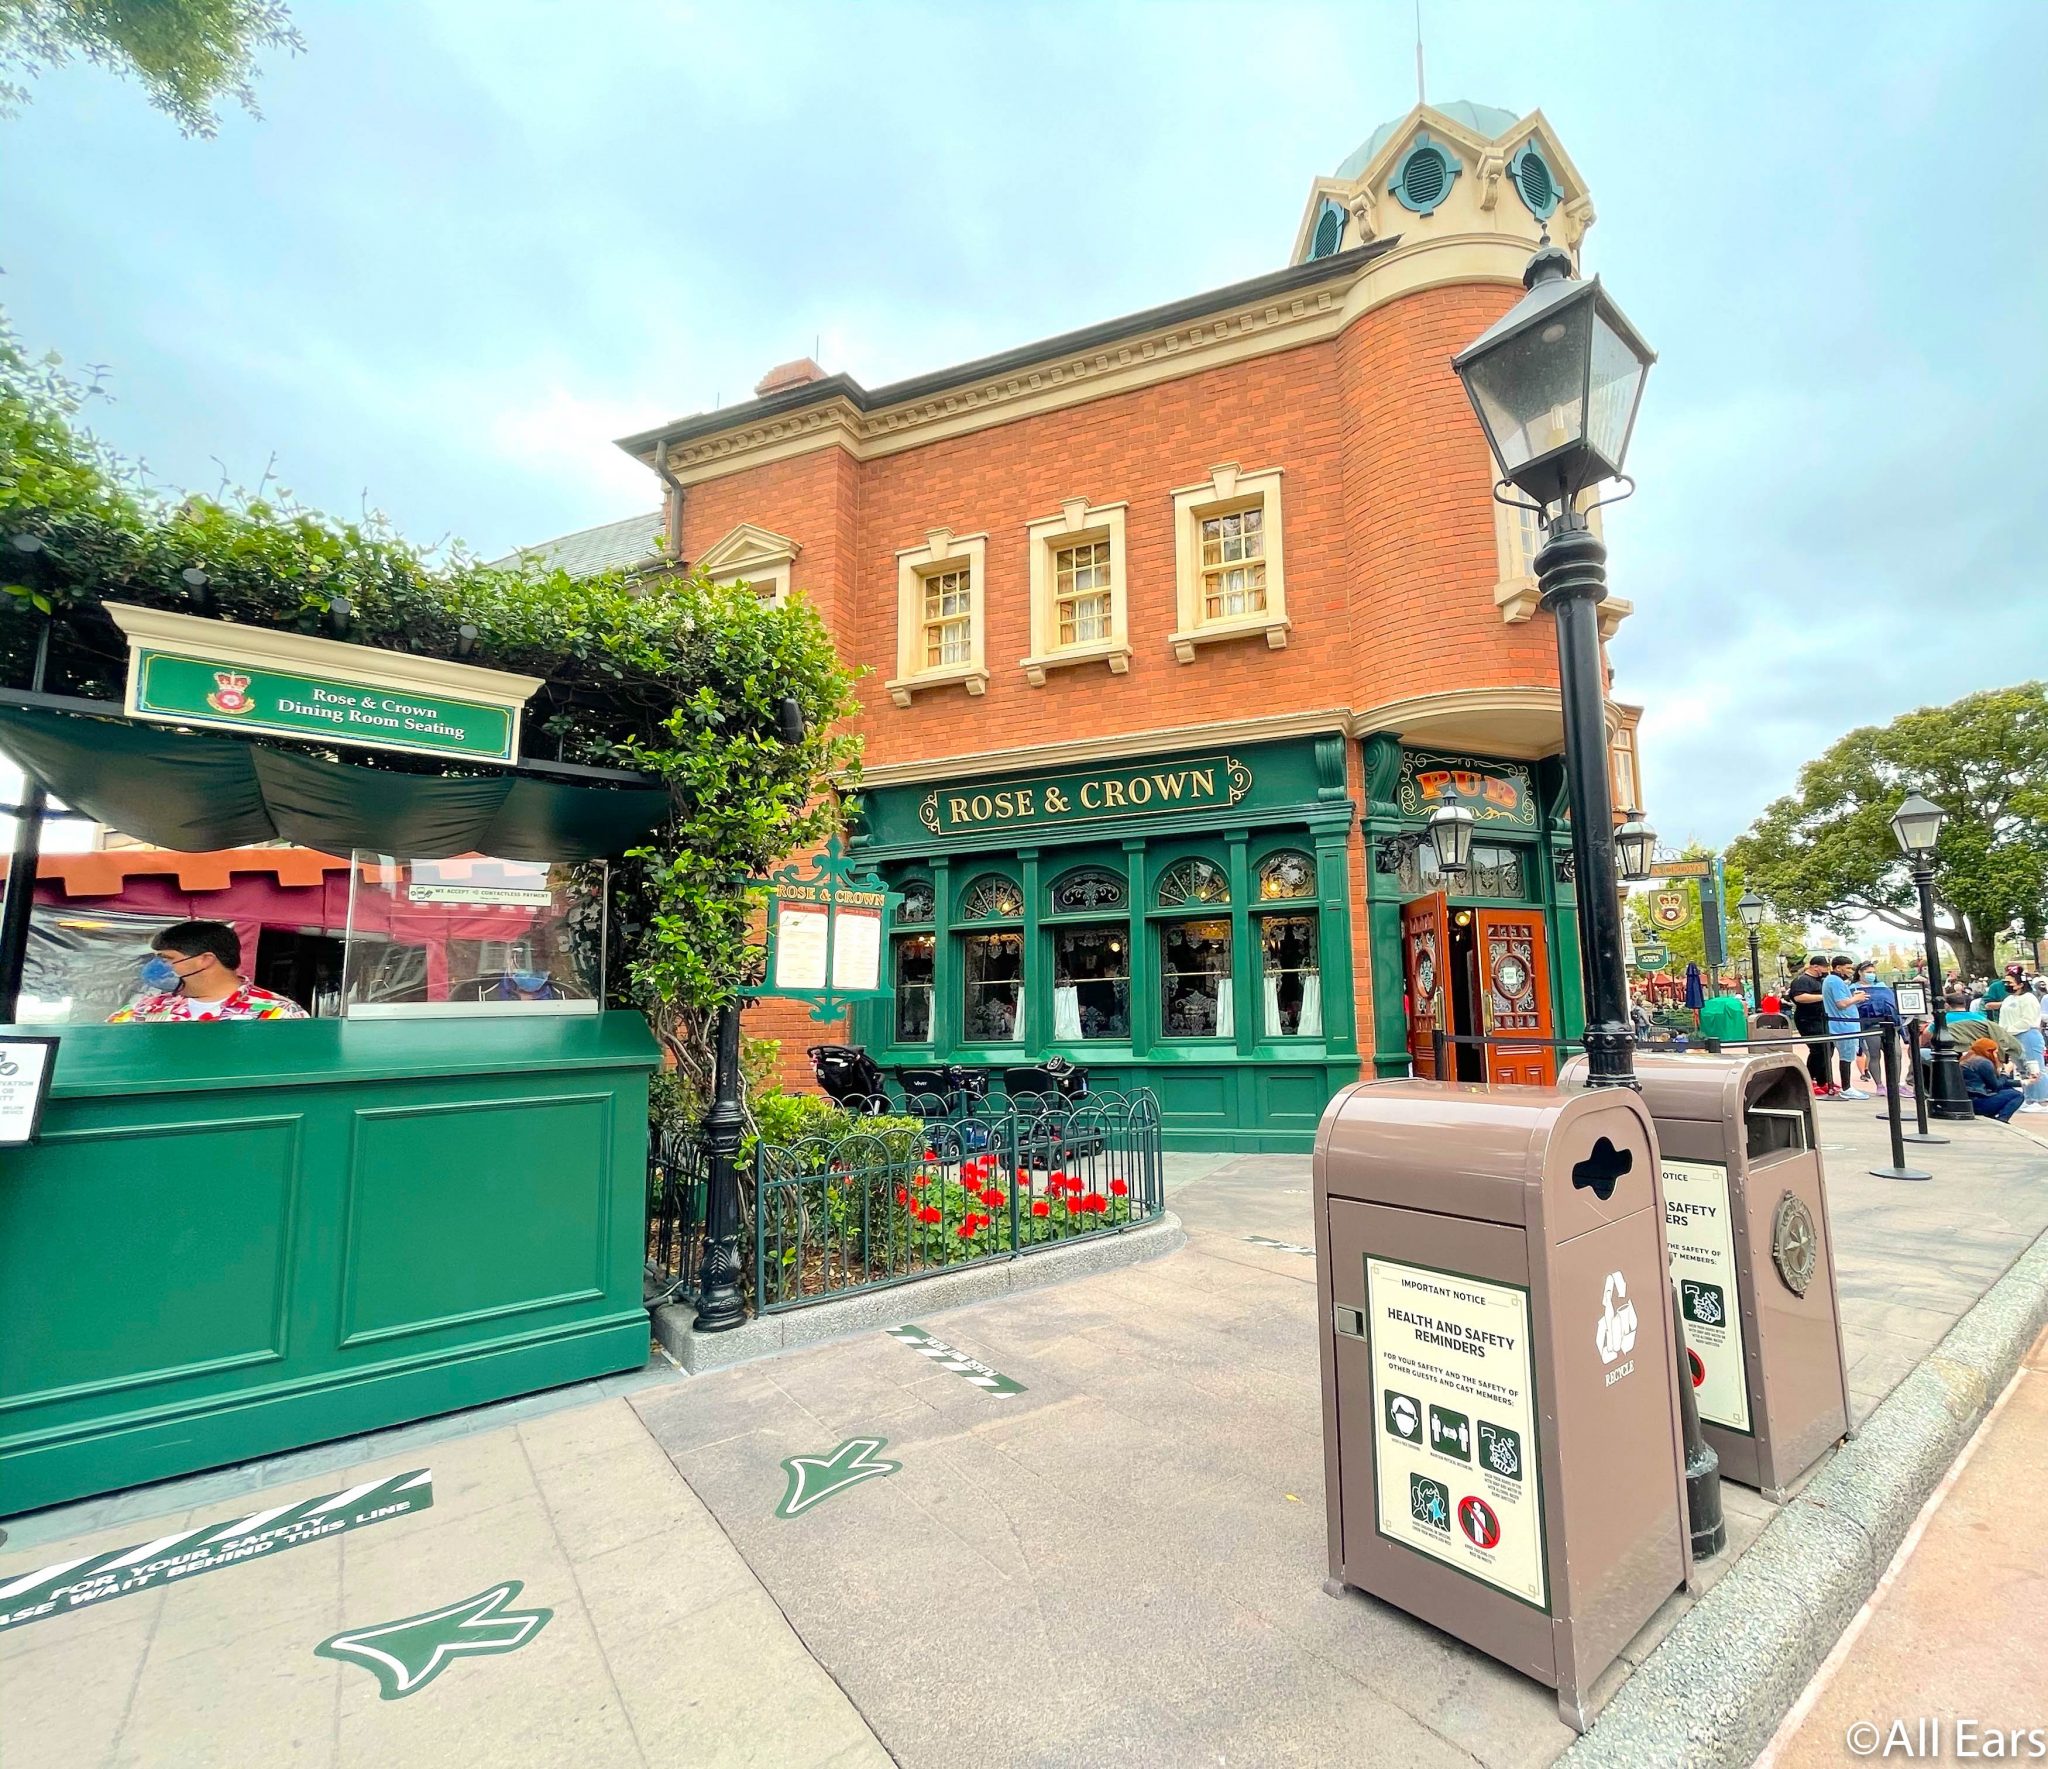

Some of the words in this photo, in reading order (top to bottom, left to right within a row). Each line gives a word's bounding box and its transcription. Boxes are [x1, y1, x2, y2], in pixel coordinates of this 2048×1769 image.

[313, 688, 356, 708] Rose
[361, 696, 376, 710] &
[381, 699, 438, 719] Crown
[278, 699, 344, 723] Dining
[348, 709, 399, 728] Room
[404, 718, 466, 740] Seating
[948, 789, 1035, 823] ROSE
[1044, 786, 1071, 814] &
[1079, 768, 1215, 810] CROWN
[1415, 771, 1517, 809] PUB
[776, 884, 816, 900] ROSE
[820, 889, 831, 901] &
[835, 890, 885, 906] CROWN
[1662, 1172, 1688, 1182] OTICE
[1665, 1214, 1688, 1226] ERS
[1668, 1201, 1717, 1218] SAFETY
[1680, 1253, 1717, 1265] MEMBERS:
[1681, 1245, 1709, 1255] SAFETY
[1401, 1278, 1451, 1297] IMPORTANT
[1453, 1291, 1486, 1305] NOTICE
[1387, 1307, 1433, 1329] HEALTH
[1436, 1320, 1462, 1336] AND
[1465, 1327, 1515, 1350] SAFETY
[1415, 1328, 1486, 1358] REMINDERS
[1383, 1351, 1397, 1361] FOR
[1398, 1356, 1416, 1366] YOUR
[1417, 1361, 1444, 1375] SAFETY
[1445, 1370, 1461, 1380] AND
[1462, 1375, 1476, 1385] THE
[1478, 1380, 1506, 1394] SAFETY
[1508, 1388, 1519, 1397] OF
[1388, 1362, 1411, 1375] OTHER
[1412, 1369, 1438, 1383] GUESTS
[1439, 1378, 1454, 1388] AND
[1456, 1382, 1474, 1393] CAST
[1476, 1389, 1514, 1407] MEMBERS:
[1605, 1360, 1634, 1387] RECYCLE
[49, 1573, 116, 1600] FOR
[130, 1548, 212, 1577] YOUR
[221, 1515, 327, 1552] SAFETY
[70, 1574, 155, 1605] WAIT
[167, 1541, 273, 1578] BEHIND
[283, 1519, 346, 1544] THIS
[355, 1500, 411, 1524] LINE
